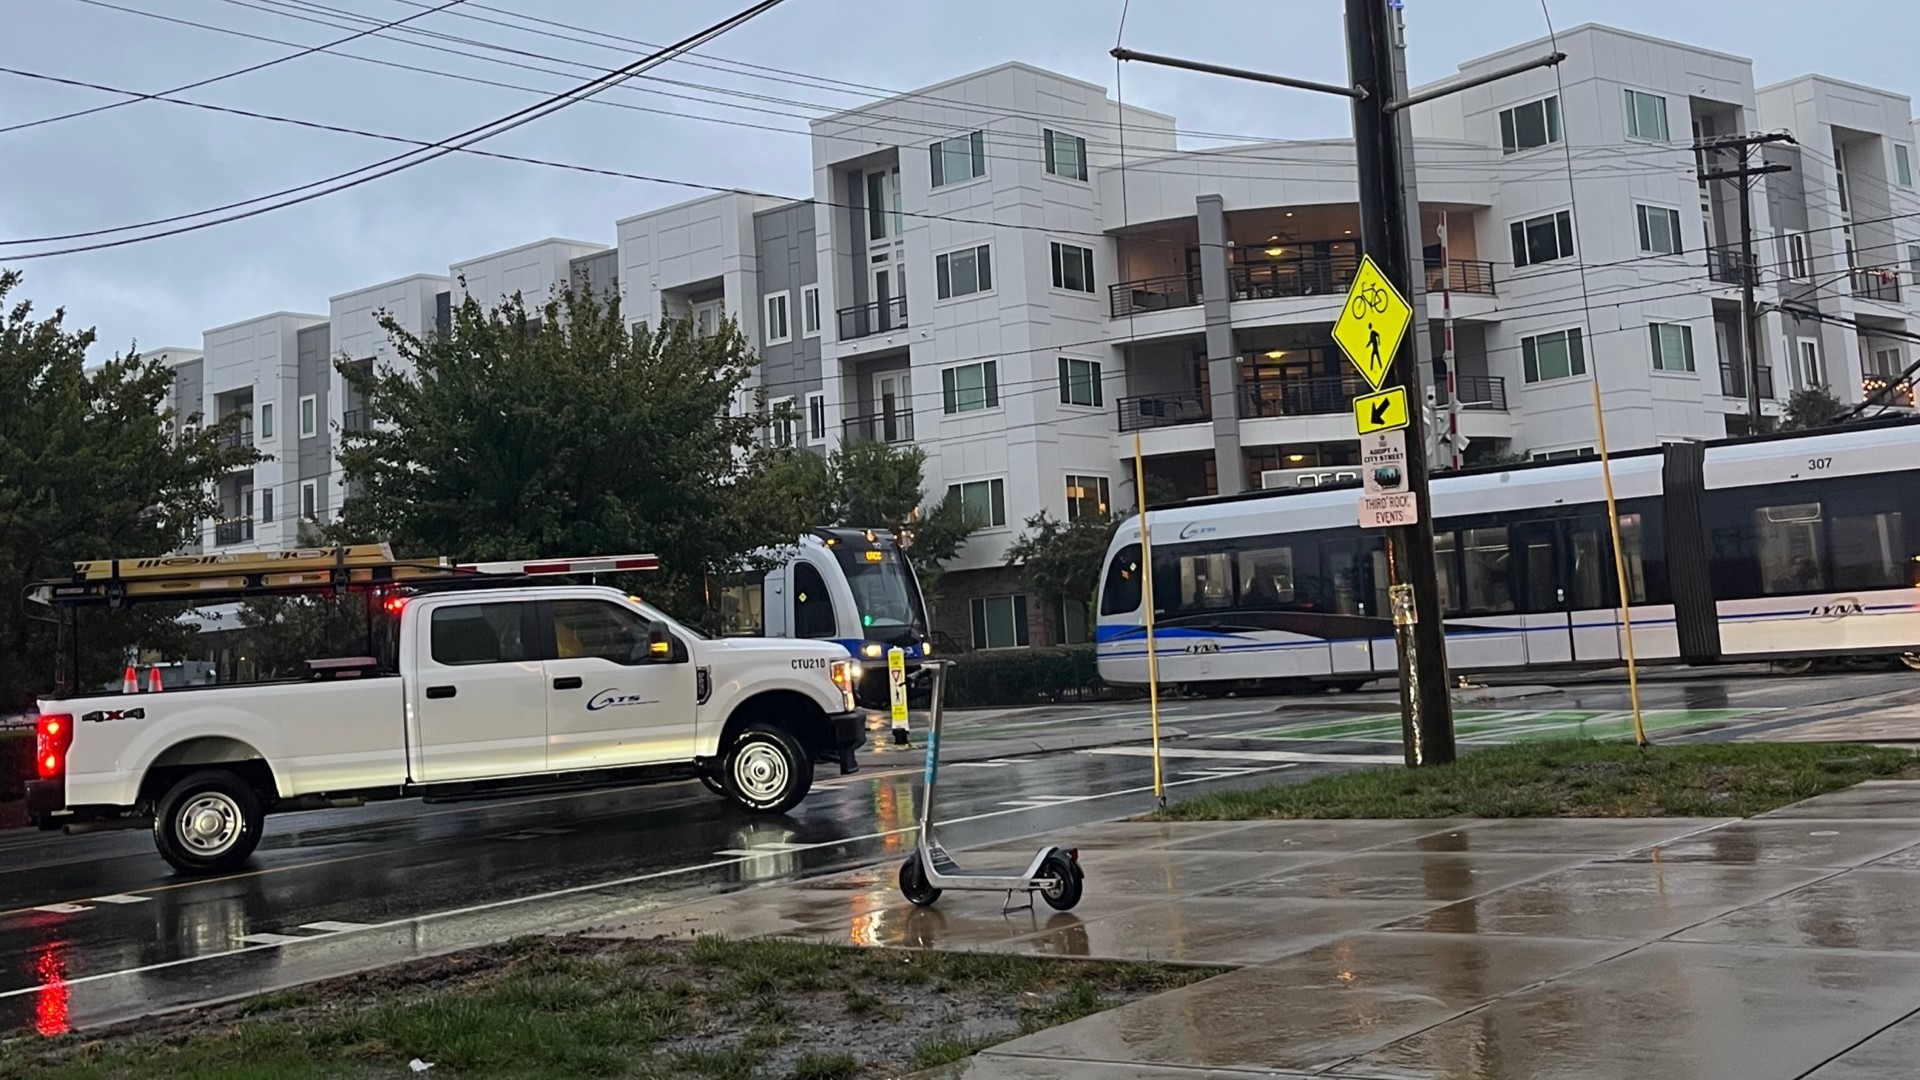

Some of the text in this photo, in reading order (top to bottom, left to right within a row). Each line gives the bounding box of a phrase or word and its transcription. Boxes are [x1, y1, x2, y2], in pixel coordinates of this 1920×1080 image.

[1369, 447, 1391, 455] ADOPT
[1380, 453, 1404, 462] STREET
[1808, 457, 1832, 470] 307
[1365, 496, 1409, 510] THIRD ROCK
[1376, 510, 1404, 523] EVENTS
[1811, 604, 1865, 616] LYNX
[1186, 644, 1220, 654] LYNX
[791, 658, 825, 669] CTU210
